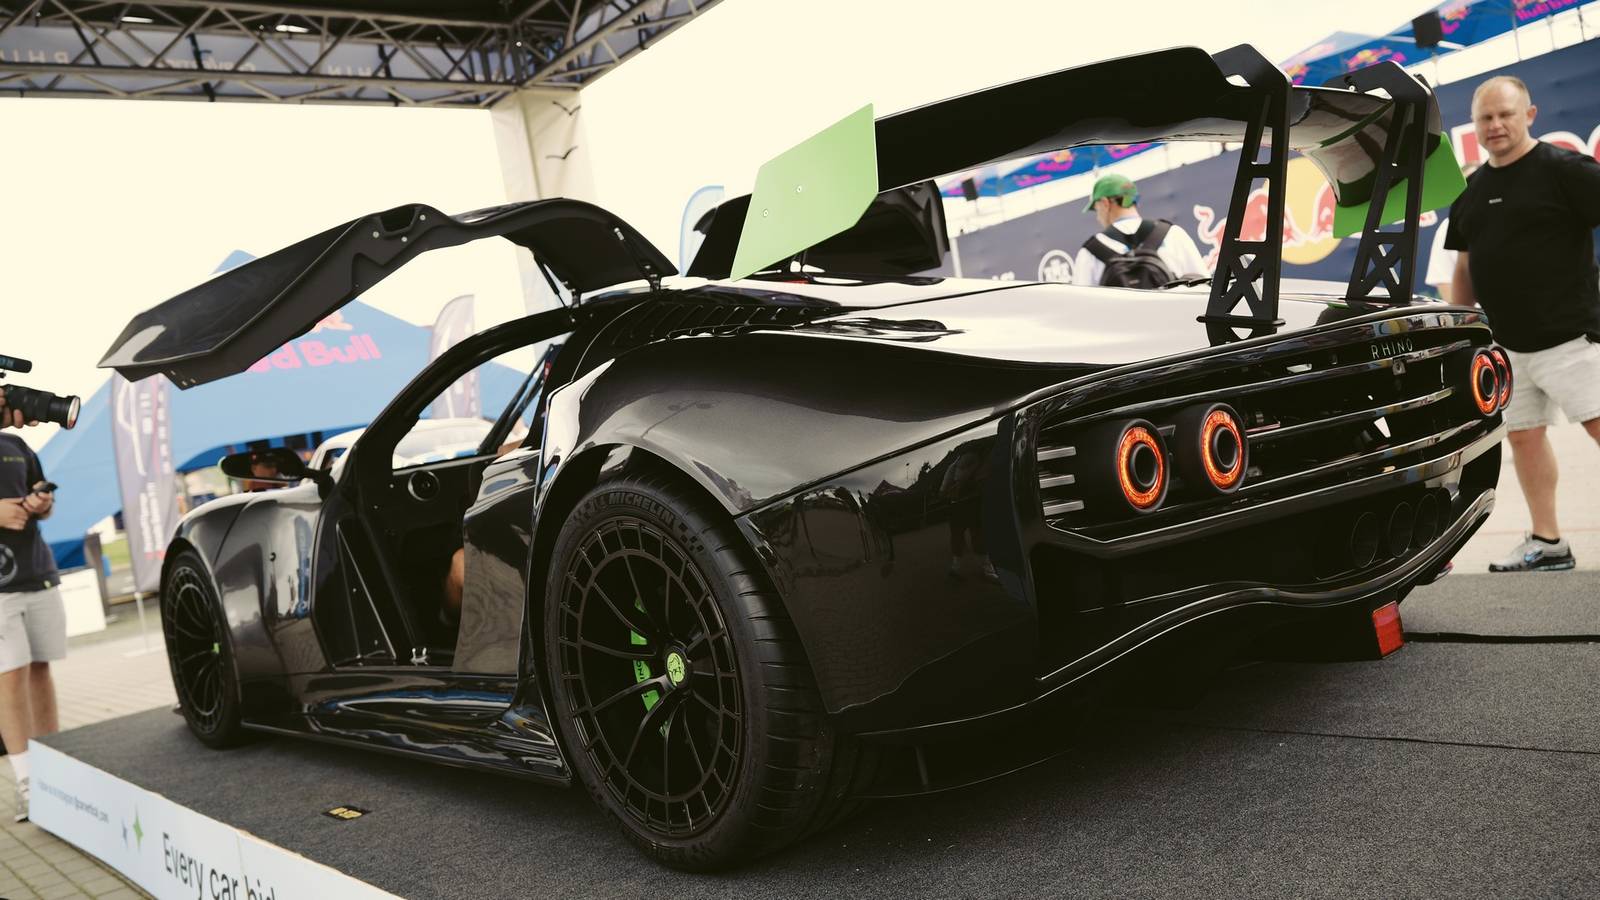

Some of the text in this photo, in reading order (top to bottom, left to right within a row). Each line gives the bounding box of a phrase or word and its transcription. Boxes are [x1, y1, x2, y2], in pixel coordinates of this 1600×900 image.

[301, 333, 381, 366] Bull
[1371, 338, 1413, 359] RHINO
[608, 491, 676, 528] MICHELIN
[162, 832, 203, 900] Every
[209, 868, 238, 900] car
